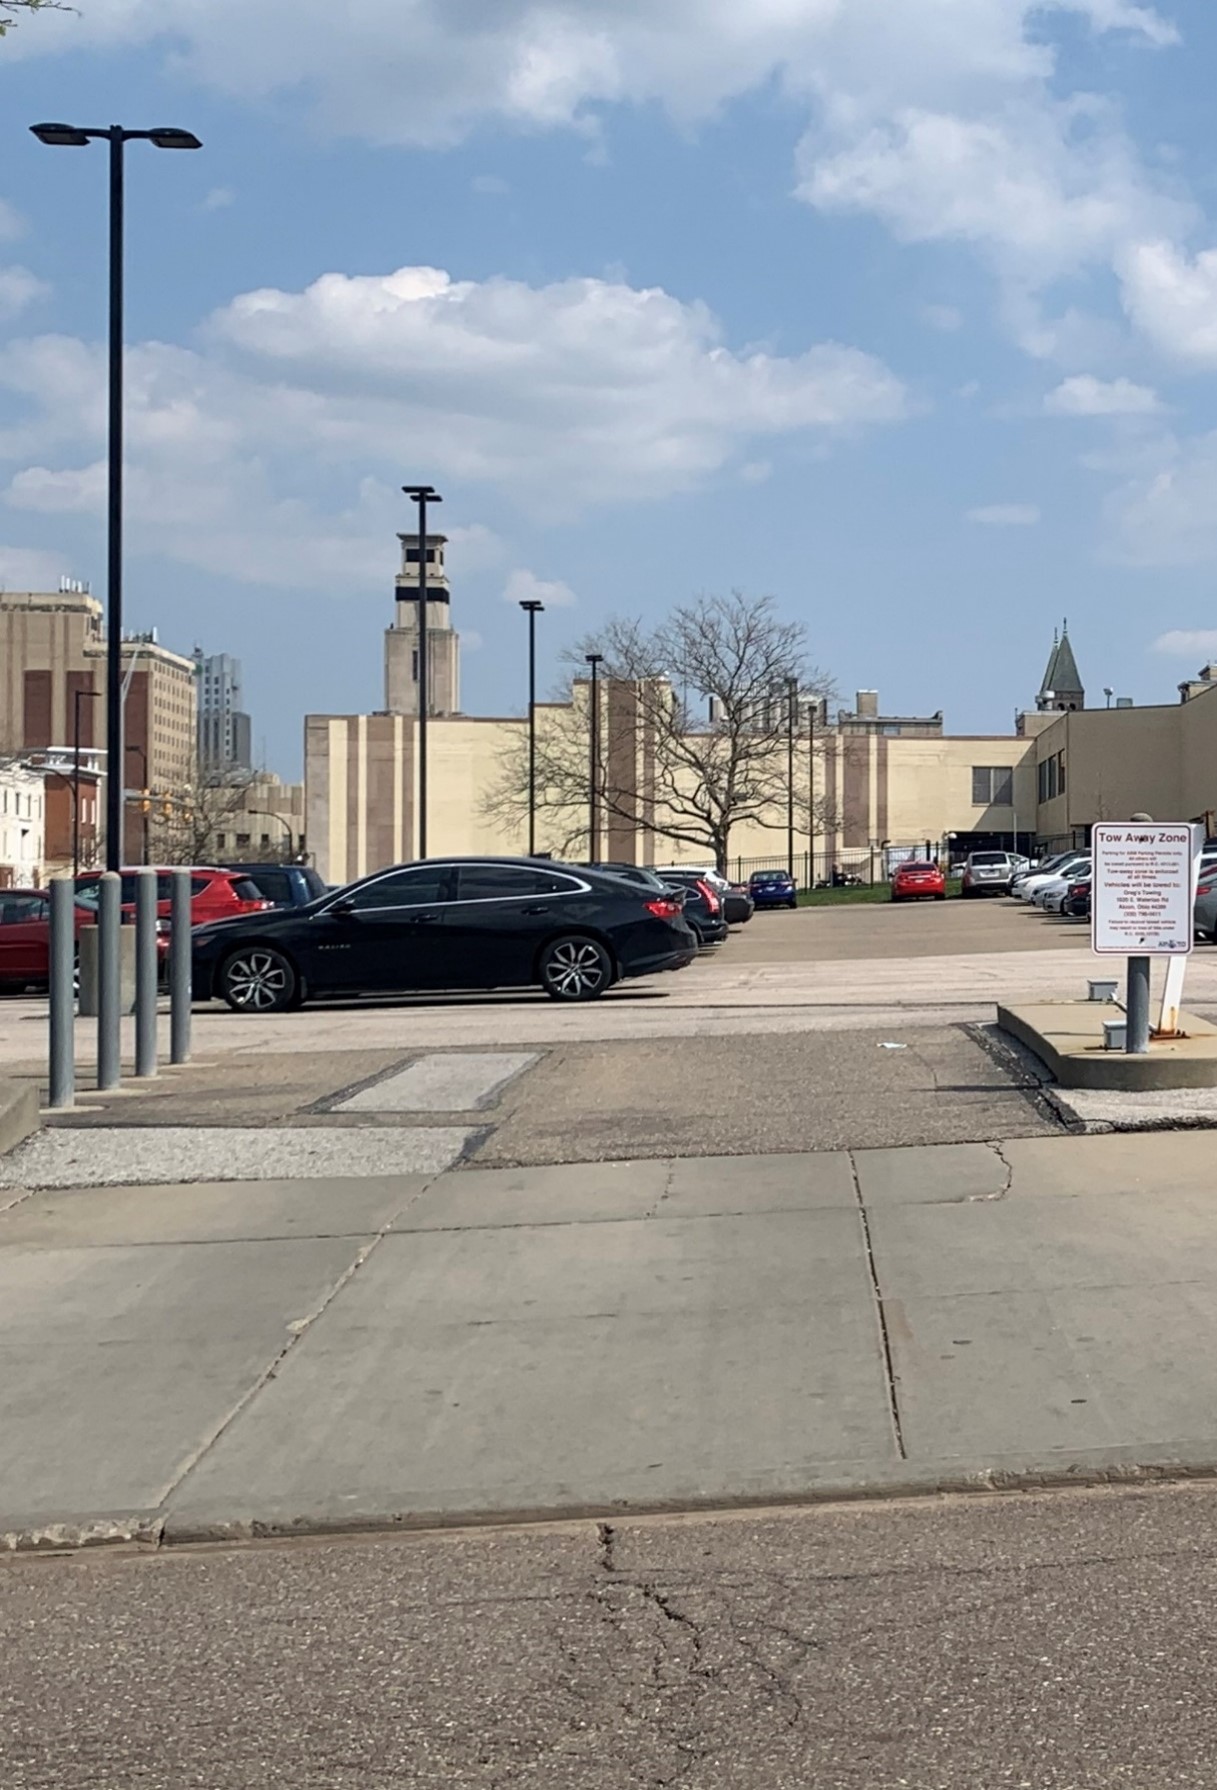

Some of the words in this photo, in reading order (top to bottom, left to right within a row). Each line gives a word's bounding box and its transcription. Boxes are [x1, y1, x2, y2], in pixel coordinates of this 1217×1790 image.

[1099, 832, 1122, 843] Tow
[1125, 832, 1156, 844] Away
[1159, 832, 1187, 843] Zone
